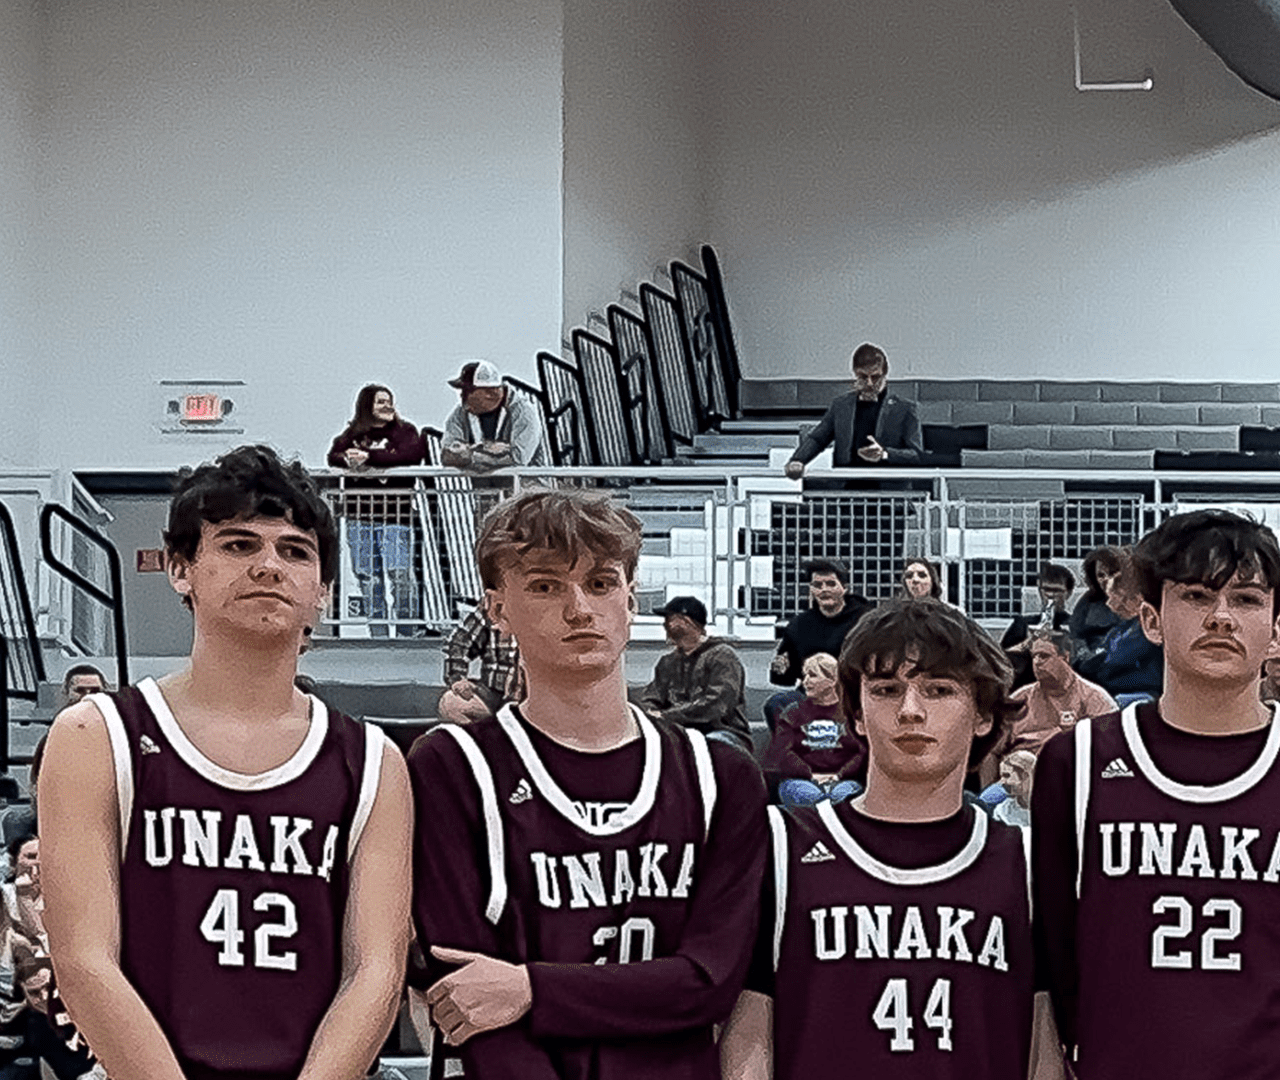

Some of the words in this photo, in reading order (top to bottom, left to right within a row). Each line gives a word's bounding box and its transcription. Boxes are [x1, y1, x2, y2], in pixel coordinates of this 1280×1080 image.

[199, 889, 298, 971] 42
[811, 905, 1008, 971] UNAKA
[1152, 896, 1241, 970] 22
[873, 978, 953, 1052] 44
